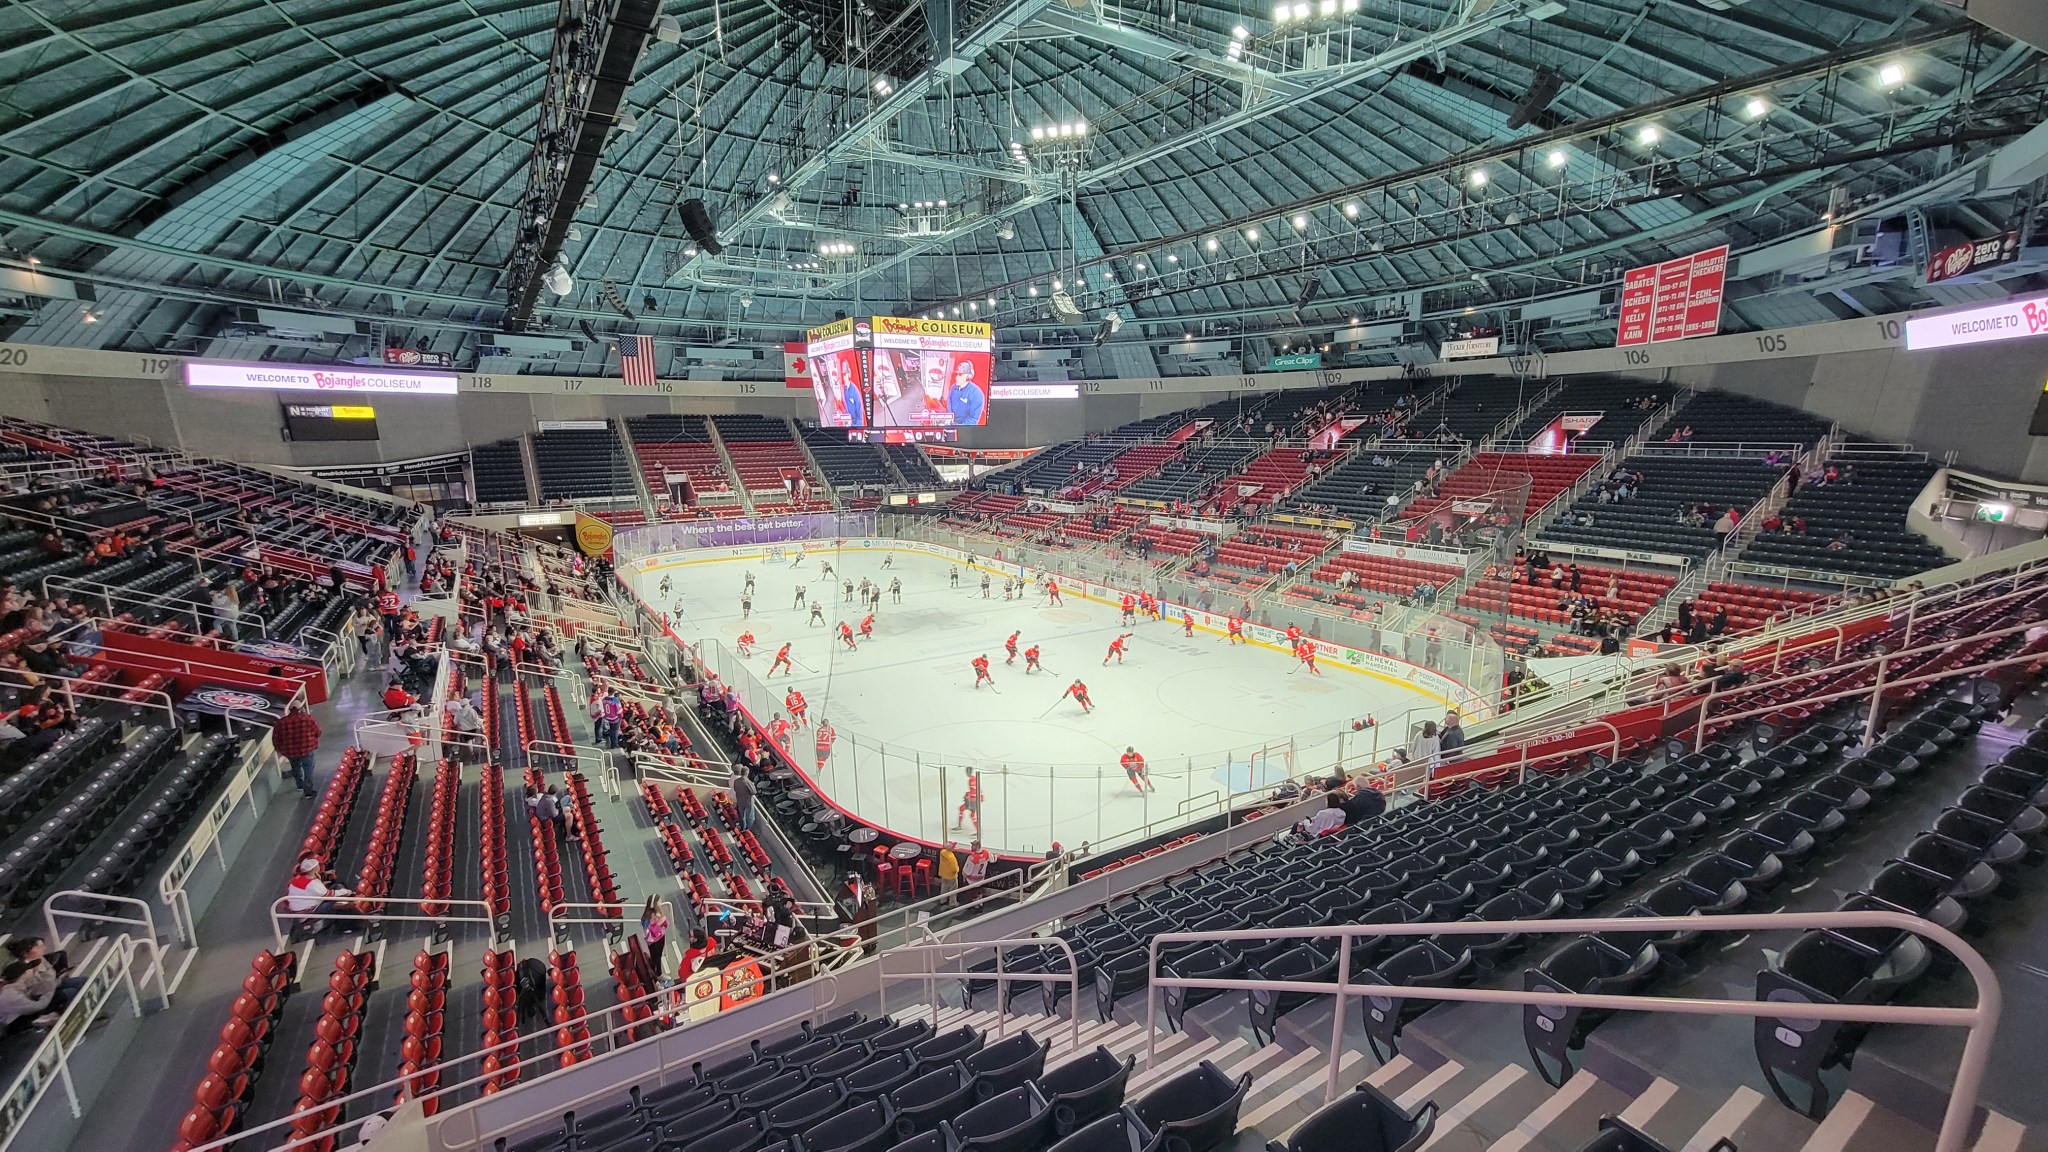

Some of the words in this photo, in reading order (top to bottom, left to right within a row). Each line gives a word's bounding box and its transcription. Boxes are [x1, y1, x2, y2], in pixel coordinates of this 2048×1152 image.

[1974, 240, 2000, 256] zero
[1693, 255, 1725, 270] CHARLOTTE
[1973, 251, 1998, 265] SUGAR
[1692, 263, 1724, 278] CHECKERS
[1624, 277, 1655, 291] SABATES
[1624, 295, 1651, 308] SCHEER
[1624, 313, 1646, 324] KELLY
[1952, 317, 2002, 335] WELCOME
[2004, 315, 2018, 328] TO
[921, 322, 984, 336] COLISEUM
[1623, 330, 1643, 341] KAHN
[1877, 320, 1900, 341] 10
[883, 337, 909, 345] WELCOME
[919, 336, 949, 349] Bojangles
[950, 340, 983, 349] COLISEUM
[1755, 335, 1787, 353] 105
[1274, 358, 1295, 366] Great
[1295, 356, 1314, 366] Clips
[1624, 350, 1650, 365] 106
[141, 358, 169, 374] 119
[246, 373, 296, 383] WELCOME
[298, 375, 309, 383] TO
[312, 372, 366, 389] Bojangles
[367, 378, 421, 389] COLISEUM
[471, 377, 492, 389] 118
[564, 380, 583, 391] 117
[1084, 382, 1100, 392] 112
[1149, 381, 1163, 390] 111
[1239, 378, 1256, 388] 110
[656, 383, 673, 393] 116
[739, 384, 756, 394] 115
[1013, 388, 1050, 396] COLISEUM
[404, 456, 460, 470] HendrickAcura.com
[317, 469, 374, 477] HendrickAcura.com
[681, 524, 714, 535] Where
[716, 523, 732, 532] the
[734, 521, 756, 531] best
[758, 522, 774, 532] get
[775, 519, 804, 529] better.
[384, 598, 396, 607] 22
[1365, 654, 1398, 668] RENEWAL
[1515, 737, 1549, 750] SETIONS
[1541, 1018, 1549, 1028] K
[1783, 1032, 1790, 1042] L
